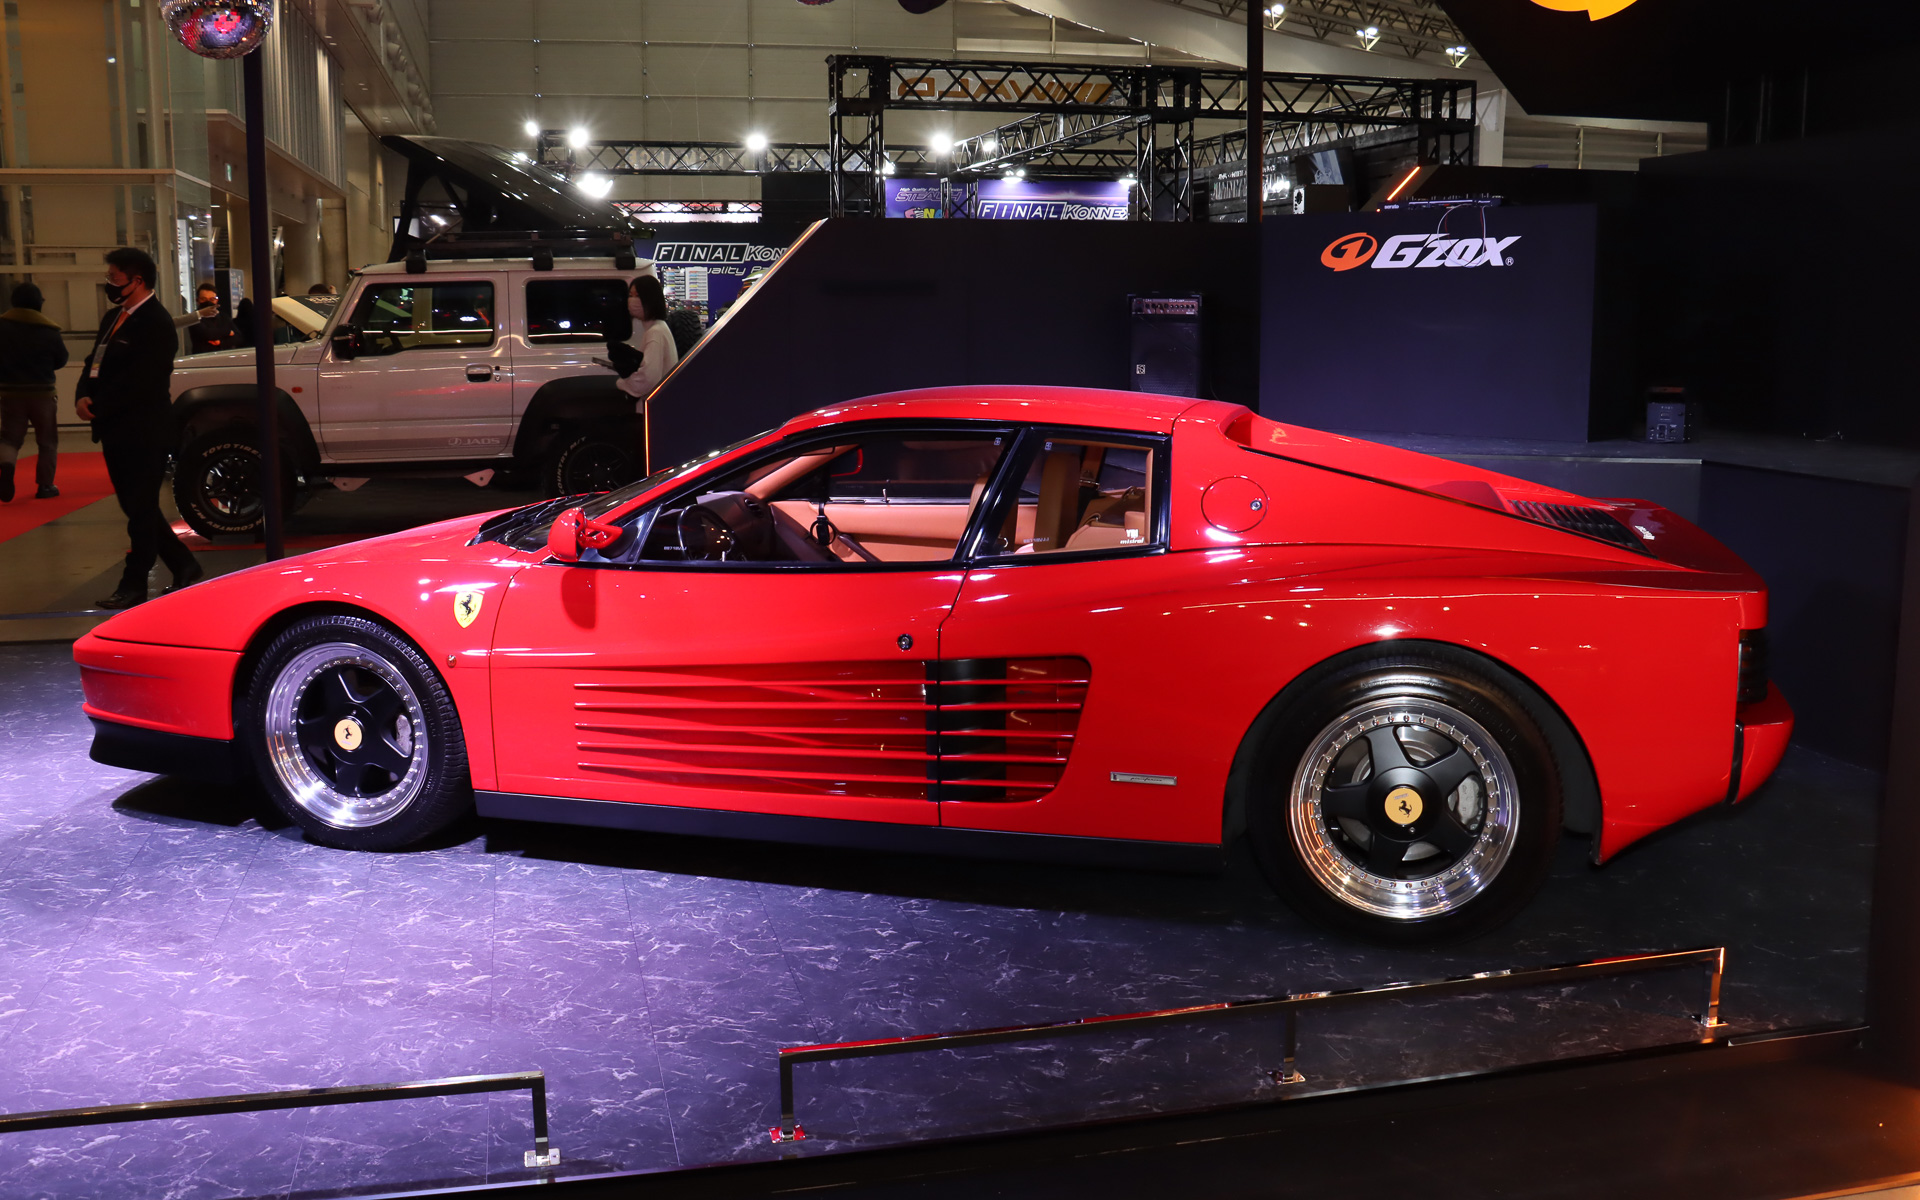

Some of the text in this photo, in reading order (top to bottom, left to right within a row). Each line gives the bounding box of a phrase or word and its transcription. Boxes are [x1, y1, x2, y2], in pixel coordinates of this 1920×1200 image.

[895, 191, 963, 202] STEALH
[979, 202, 1063, 219] FINAL
[655, 244, 747, 262] FINAL
[202, 443, 231, 458] TOYO
